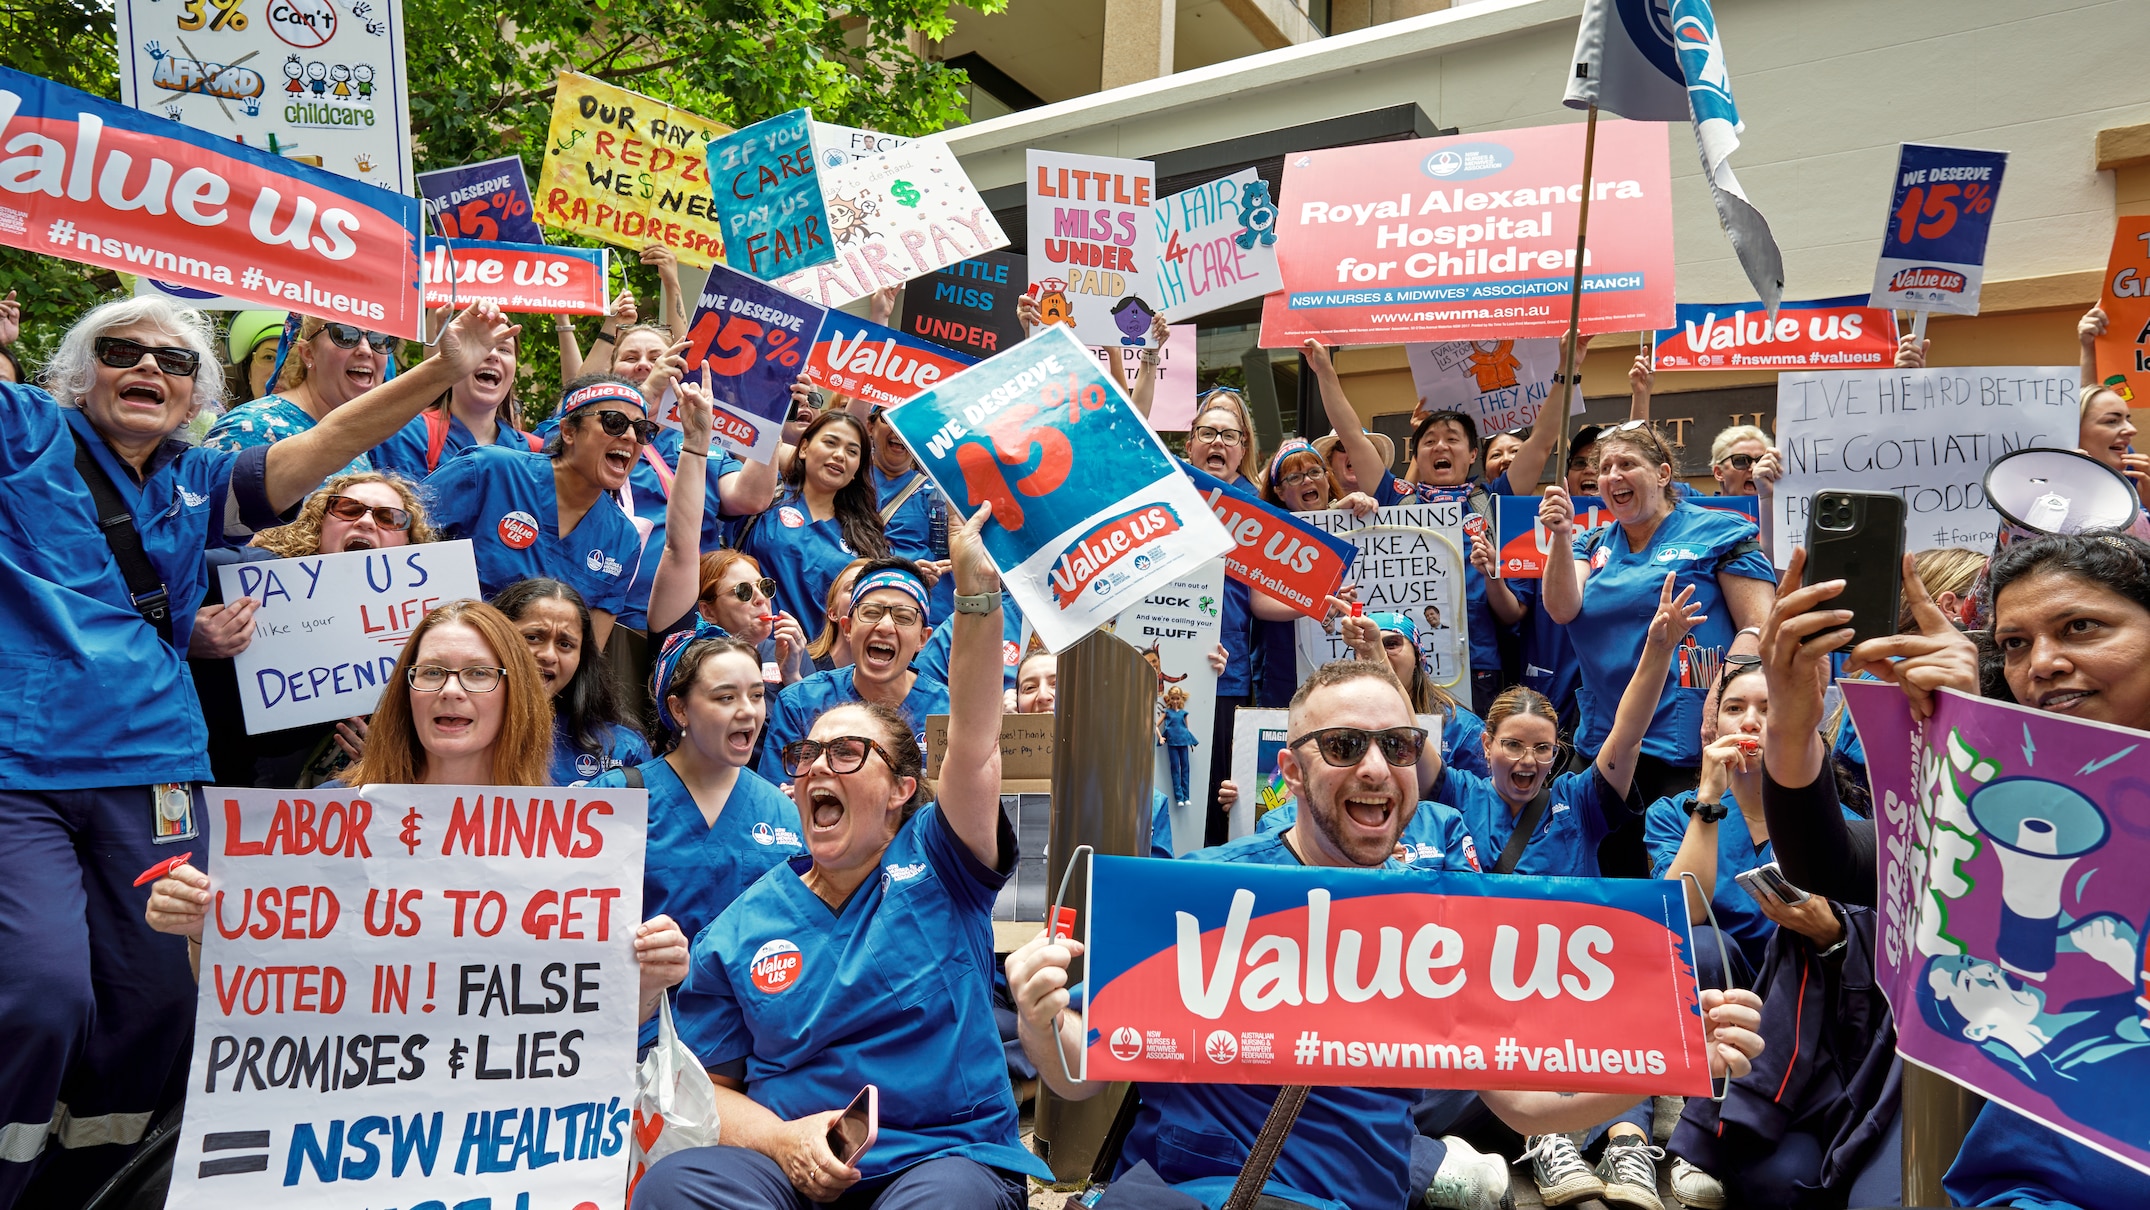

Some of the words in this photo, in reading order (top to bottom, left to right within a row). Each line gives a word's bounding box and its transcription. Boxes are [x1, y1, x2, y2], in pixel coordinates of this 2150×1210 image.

[176, 0, 249, 32] 3%
[273, 6, 334, 29] Can't
[154, 57, 262, 98] AFFORD
[284, 102, 375, 127] childcare
[578, 95, 635, 132] OUR
[651, 118, 694, 149] PAY
[595, 131, 711, 184] REDZ
[720, 138, 757, 171] IF
[765, 124, 805, 153] YOU
[0, 90, 231, 226] alue
[249, 186, 360, 260] us
[732, 144, 815, 201] CARE
[1038, 166, 1150, 207] LITTLE
[1902, 169, 1927, 187] WE
[1928, 166, 1992, 182] DESERVE
[426, 195, 450, 216] WE
[450, 175, 511, 206] DESERVE
[658, 188, 720, 223] NEE
[730, 204, 769, 237] PAY
[781, 190, 810, 216] US
[1180, 178, 1240, 232] FAIR
[1300, 193, 1411, 226] Royal
[1418, 176, 1643, 216] Alexandra
[1895, 183, 1992, 245] 15%
[439, 190, 526, 241] 15%
[1054, 207, 1137, 247] MISS
[1376, 211, 1552, 249] Hospital
[746, 215, 825, 273] FAIR
[776, 242, 908, 307] FAIR
[900, 206, 993, 272] PAY
[1045, 238, 1138, 273] UNDER
[1165, 229, 1188, 263] 4
[1187, 227, 1260, 297] CARE
[48, 218, 234, 286] #nswnma
[241, 266, 385, 321] #valueus
[513, 260, 570, 287] us
[1068, 268, 1126, 297] PAID
[1336, 257, 1397, 283] for
[1404, 245, 1592, 279] Children
[1896, 268, 1939, 288] Value
[1942, 273, 1961, 288] us
[511, 295, 586, 309] #valueus
[935, 282, 994, 311] MISS
[1292, 295, 1324, 307] NSW
[1326, 292, 1381, 305] NURSES
[1384, 292, 1393, 302] &
[1397, 287, 1469, 302] MIDWIVES'
[1472, 281, 1569, 298] ASSOCIATION
[1580, 276, 1640, 290] RANCH
[699, 292, 726, 310] WE
[729, 298, 805, 333] DESERVE
[1371, 305, 1550, 324] www.nswnma.asn.au
[1685, 310, 1800, 353] Value
[1809, 313, 1863, 342] us
[684, 311, 801, 377] 15%
[914, 314, 998, 351] UNDER
[827, 329, 941, 388] Value
[1731, 352, 1807, 366] #nswnma
[1809, 350, 1882, 364] #valueus
[567, 386, 615, 406] Value
[617, 386, 639, 400] us
[925, 415, 967, 460] WE
[962, 354, 1065, 424] DESERVE
[1474, 387, 1519, 415] THEY
[1878, 376, 1971, 414] HEARD
[1980, 377, 2077, 407] BETTER
[727, 419, 753, 440] us
[956, 372, 1106, 531] 15%
[503, 518, 534, 539] Value
[507, 530, 523, 543] us
[1373, 506, 1459, 530] MINNS
[1050, 529, 1132, 593] Value
[1129, 507, 1167, 543] us
[1263, 530, 1320, 574] us
[1351, 535, 1404, 557] LIKE
[1410, 533, 1430, 554] A
[238, 560, 323, 608] PAY
[366, 552, 429, 594] US
[1174, 581, 1187, 589] run
[1248, 566, 1314, 608] #valueus
[1136, 613, 1150, 621] And
[1171, 616, 1195, 627] calling
[1144, 595, 1192, 608] LUCK
[255, 621, 291, 639] like
[301, 615, 336, 633] your
[1143, 626, 1198, 639] BLUFF
[1018, 729, 1046, 740] Thank
[1021, 746, 1032, 757] pay
[224, 799, 373, 859] LABOR
[399, 806, 425, 856] &
[441, 796, 615, 860] MINNS
[1914, 726, 1997, 957] PAY!
[1900, 806, 1918, 898] WANNA
[1903, 743, 1941, 962] FAIR
[1884, 789, 1908, 967] GIRLS
[214, 885, 342, 941] USED
[364, 888, 424, 938] US
[444, 889, 508, 938] TO
[521, 888, 621, 942] GET
[757, 955, 797, 977] Value
[1175, 887, 1467, 1020] Value
[1489, 923, 1616, 1002] us
[214, 964, 347, 1016] VOTED
[457, 962, 602, 1018] FALSE
[768, 968, 787, 985] us
[1146, 1030, 1161, 1038] NSW
[1146, 1037, 1171, 1046] NURSES
[1146, 1044, 1178, 1053] MIDWIVES'
[1241, 1031, 1275, 1040] AUSTRALIAN
[1241, 1038, 1265, 1047] NURSING
[1265, 1039, 1271, 1047] &
[1241, 1045, 1272, 1053] MIDWIFERY
[1294, 1030, 1487, 1071] #nswnma
[1495, 1037, 1667, 1075] #valueus
[205, 1033, 430, 1094] PROMISES
[475, 1029, 585, 1081] LIES
[1146, 1052, 1185, 1061] ASSOCIATION
[1241, 1051, 1275, 1060] FEDERATION
[282, 1111, 445, 1187] NSW
[453, 1096, 631, 1175] HEALTH'S
